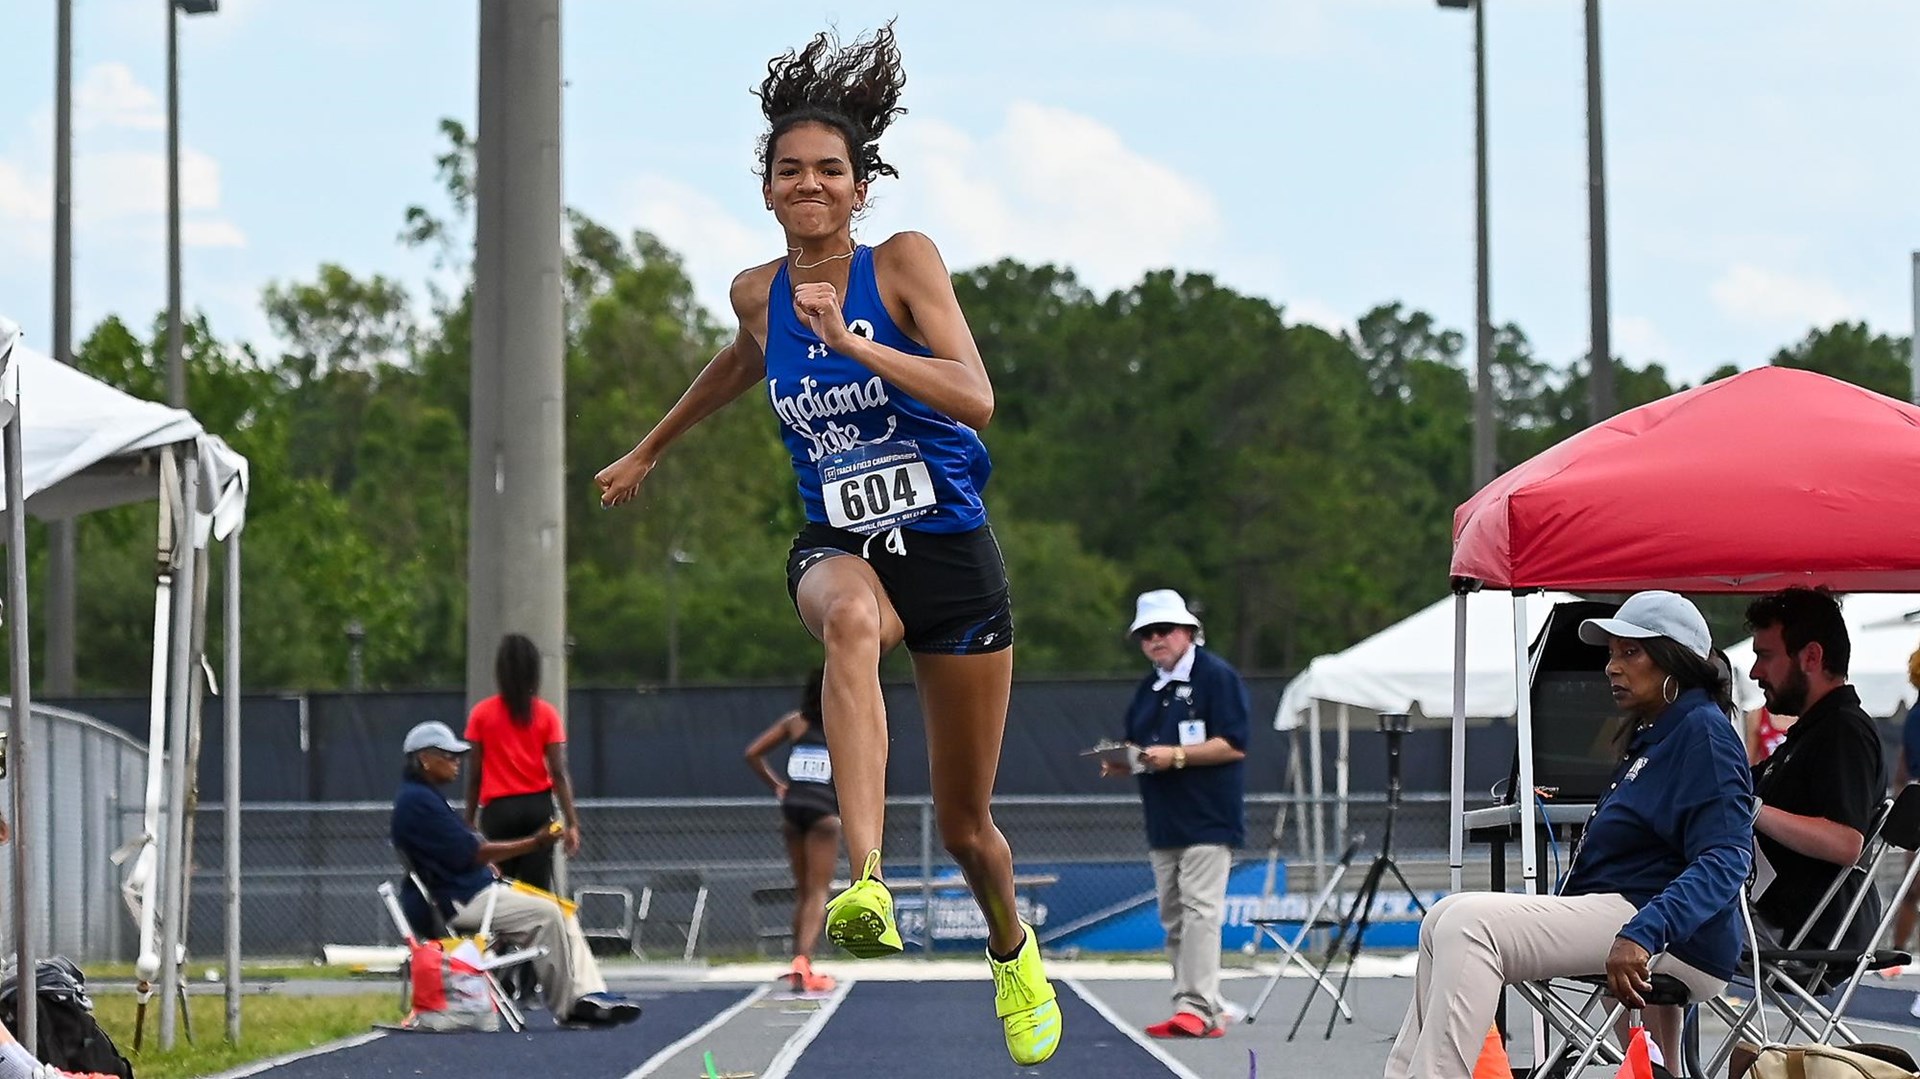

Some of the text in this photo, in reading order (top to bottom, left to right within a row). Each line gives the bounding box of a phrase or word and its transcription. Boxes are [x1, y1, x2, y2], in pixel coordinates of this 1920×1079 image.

[770, 376, 888, 425] Indiana
[792, 418, 884, 462] State
[840, 467, 917, 520] 604
